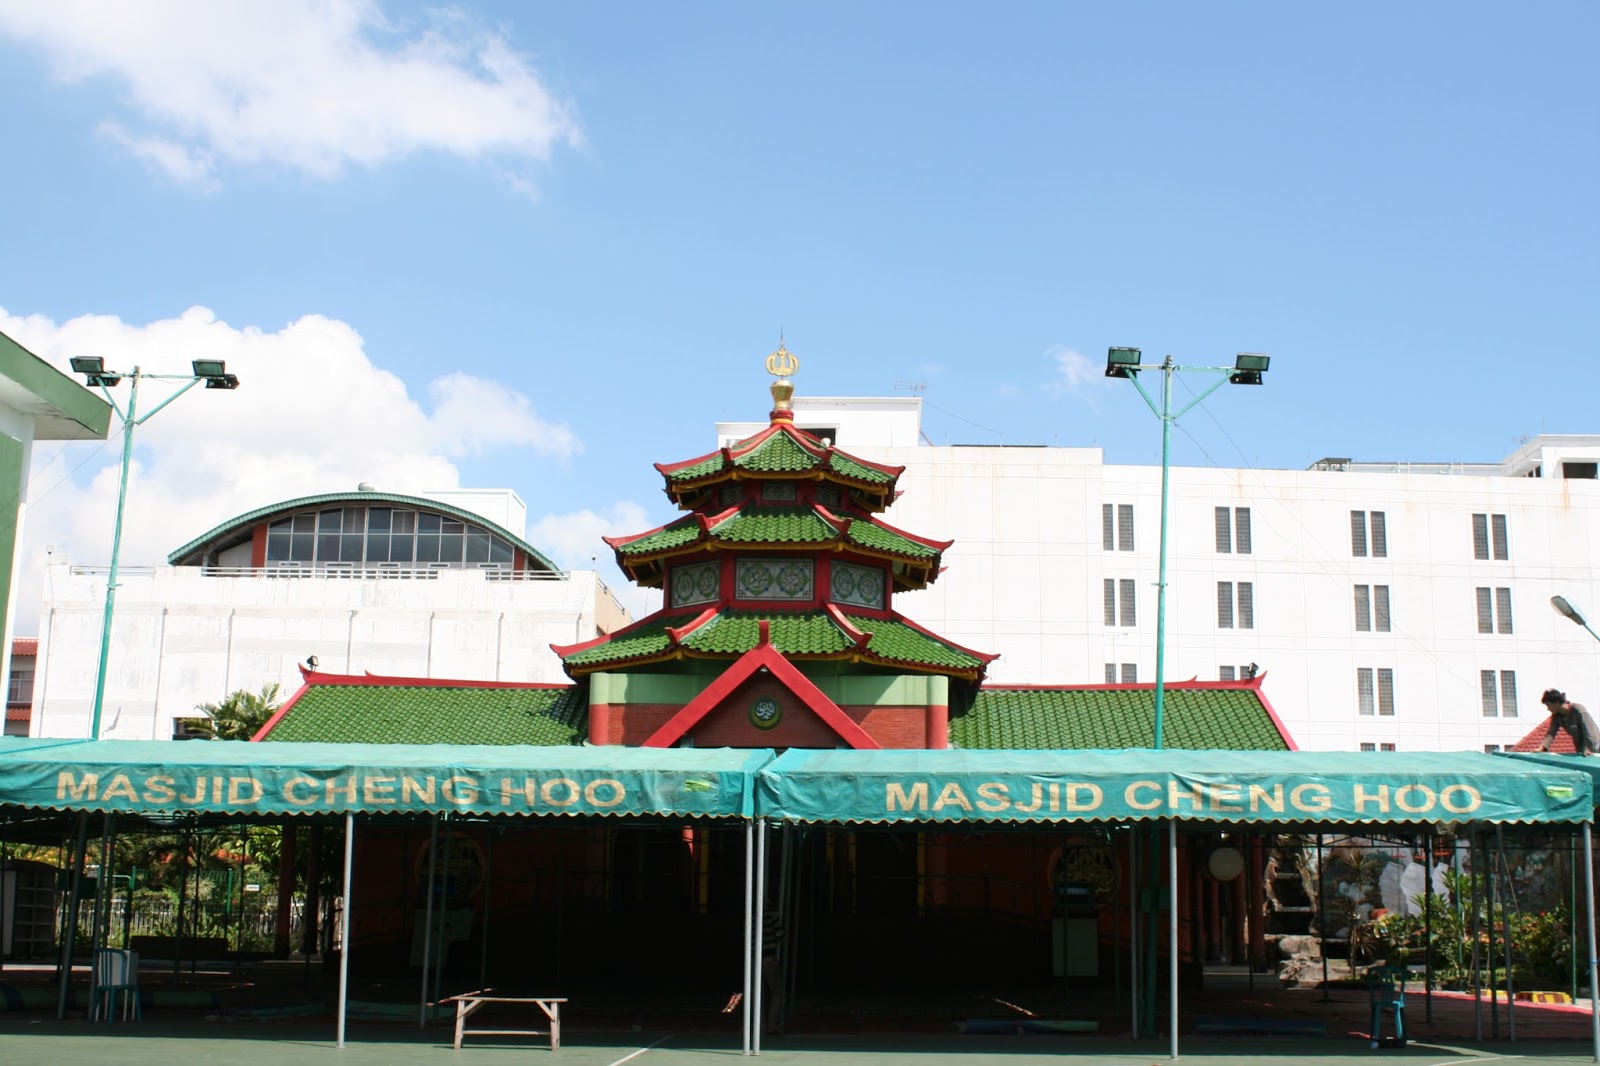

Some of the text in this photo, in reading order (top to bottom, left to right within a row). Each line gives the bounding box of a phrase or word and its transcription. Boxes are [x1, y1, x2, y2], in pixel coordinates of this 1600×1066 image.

[56, 772, 626, 808] MASJID CHENG HOO
[886, 781, 1482, 814] MASJID CHENG HOO
